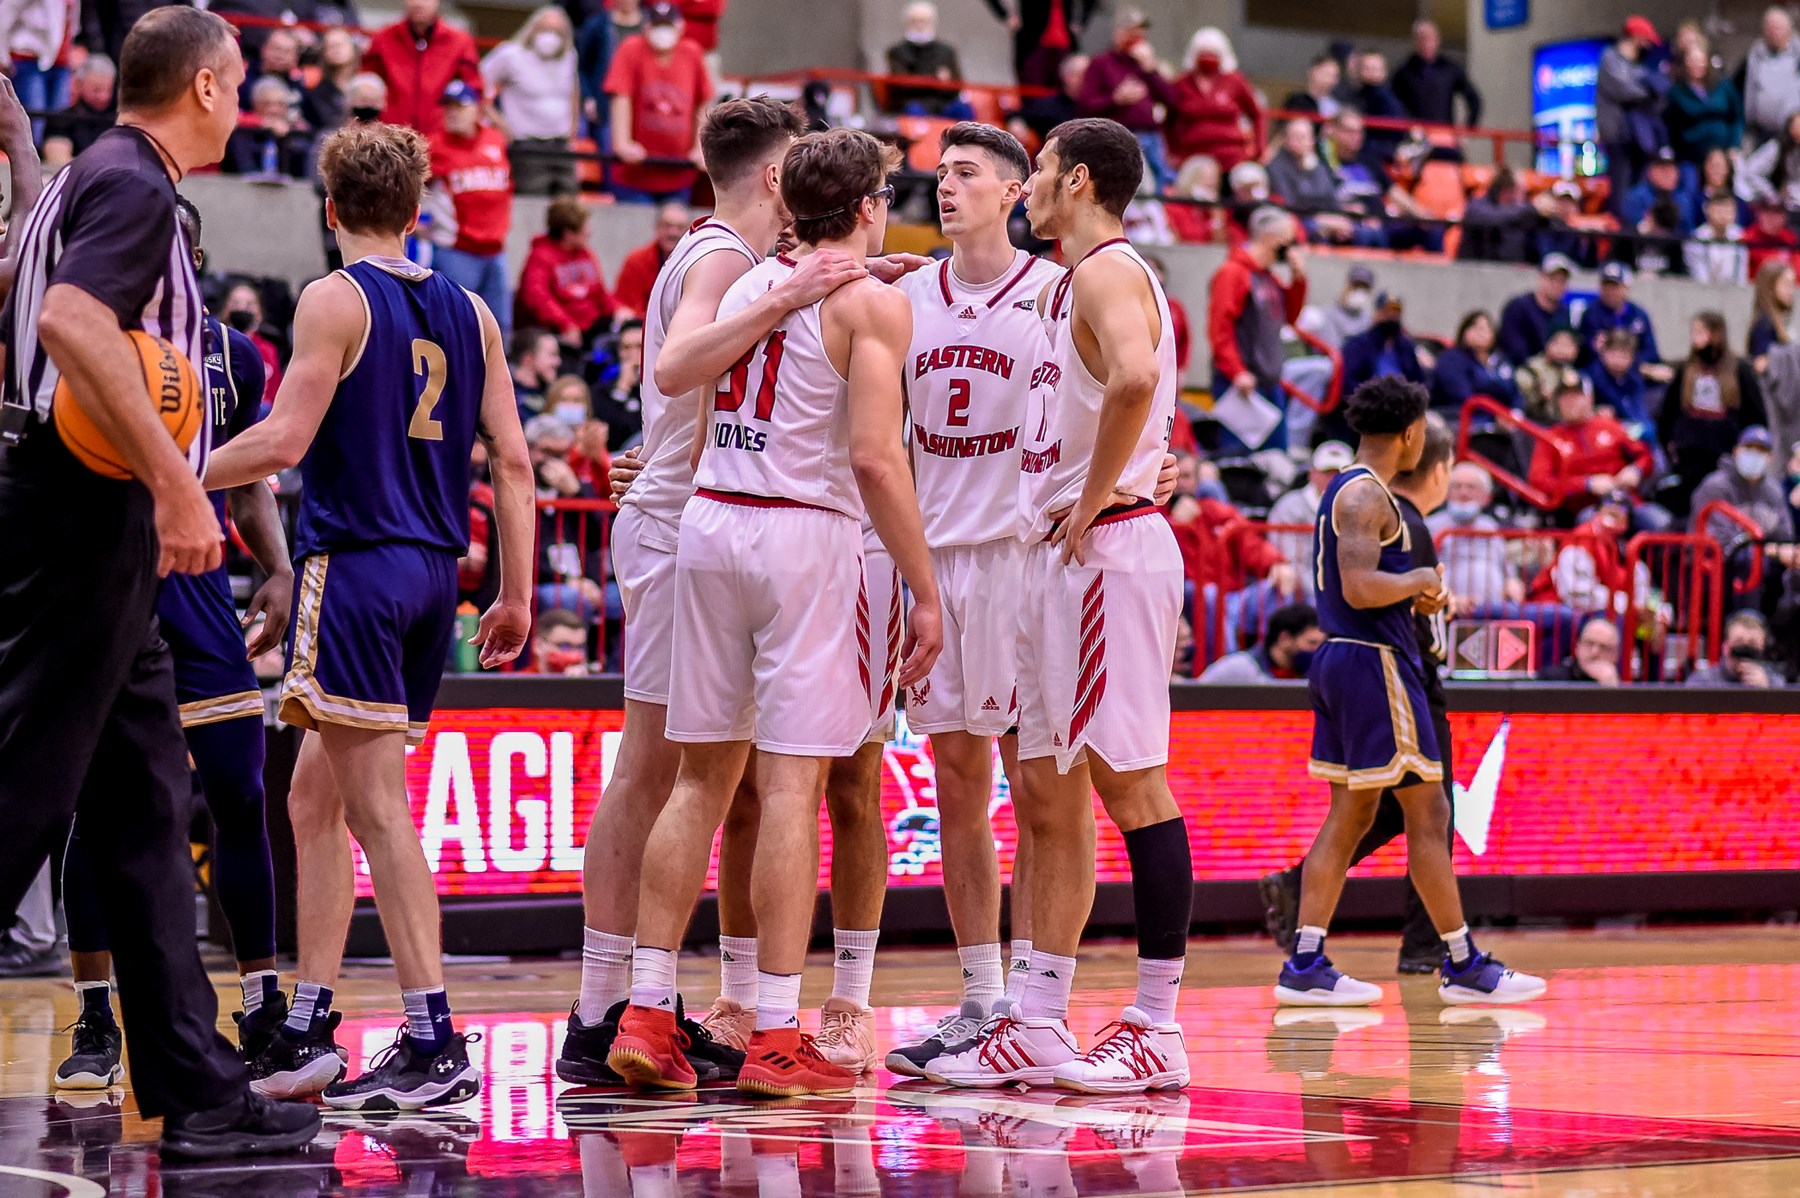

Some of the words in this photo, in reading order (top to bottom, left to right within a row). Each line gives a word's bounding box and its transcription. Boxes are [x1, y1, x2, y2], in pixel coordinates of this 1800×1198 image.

[408, 338, 447, 440] 2
[714, 329, 787, 422] 31
[914, 344, 1016, 381] EASTERN
[946, 378, 971, 427] 2
[360, 731, 624, 874] AGL
